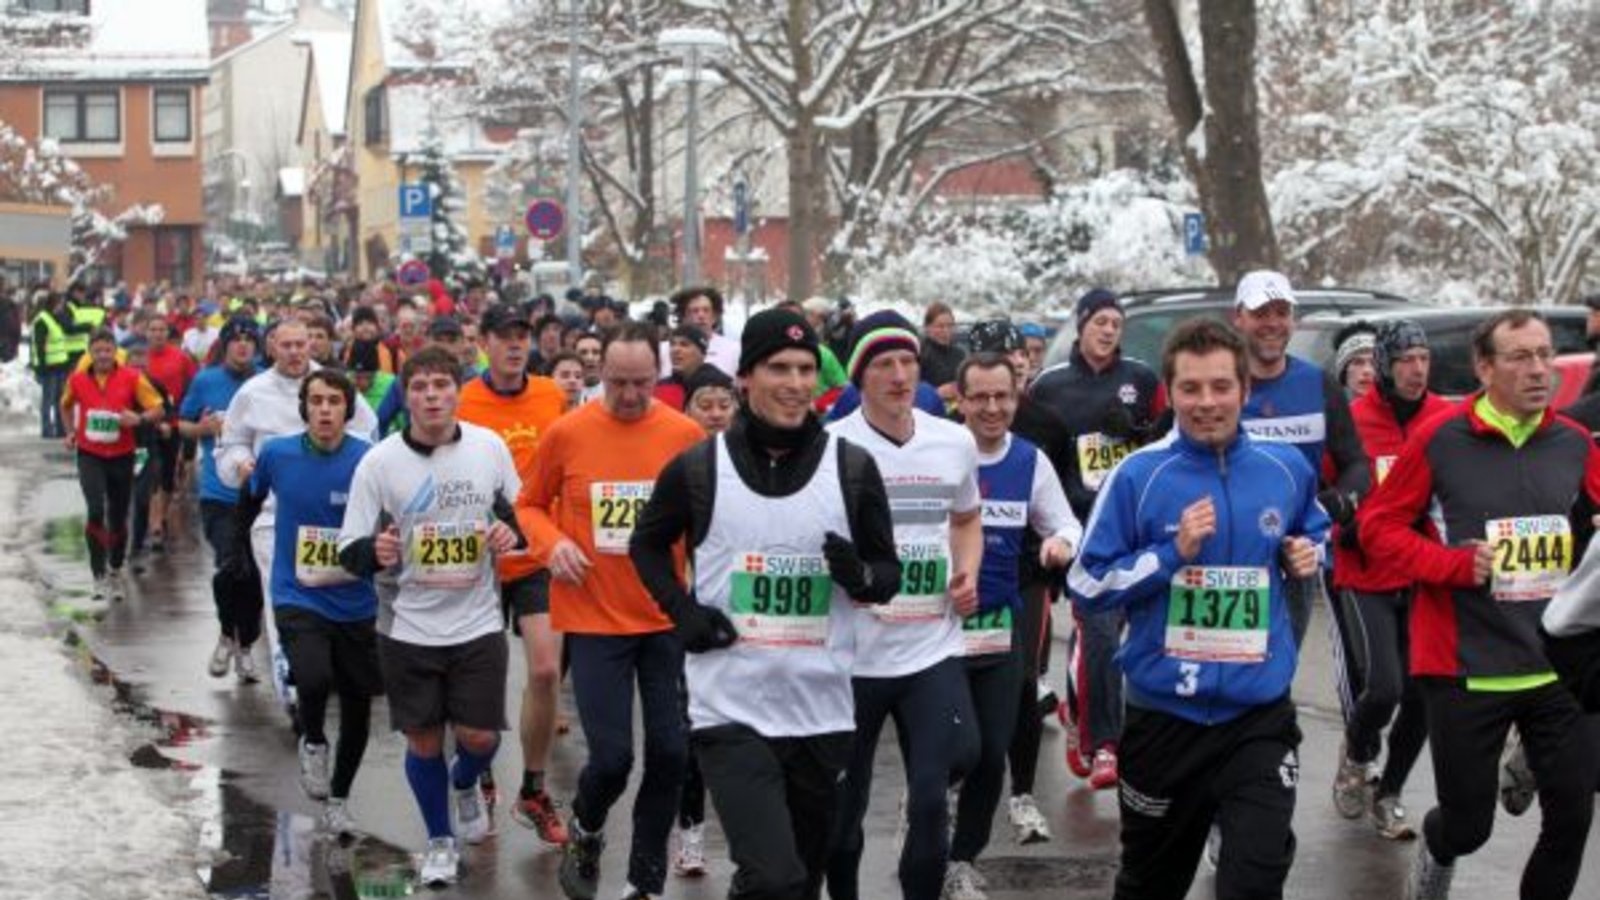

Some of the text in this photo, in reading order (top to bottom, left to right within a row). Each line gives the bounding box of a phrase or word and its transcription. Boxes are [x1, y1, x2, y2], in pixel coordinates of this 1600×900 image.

[405, 188, 425, 214] P
[420, 535, 479, 565] 2339
[767, 556, 797, 574] SW
[1497, 534, 1565, 572] 2444
[897, 560, 937, 595] 99
[1206, 570, 1260, 588] SW BB
[752, 575, 812, 616] 998
[1180, 588, 1260, 630] 1379
[1175, 661, 1200, 696] 3
